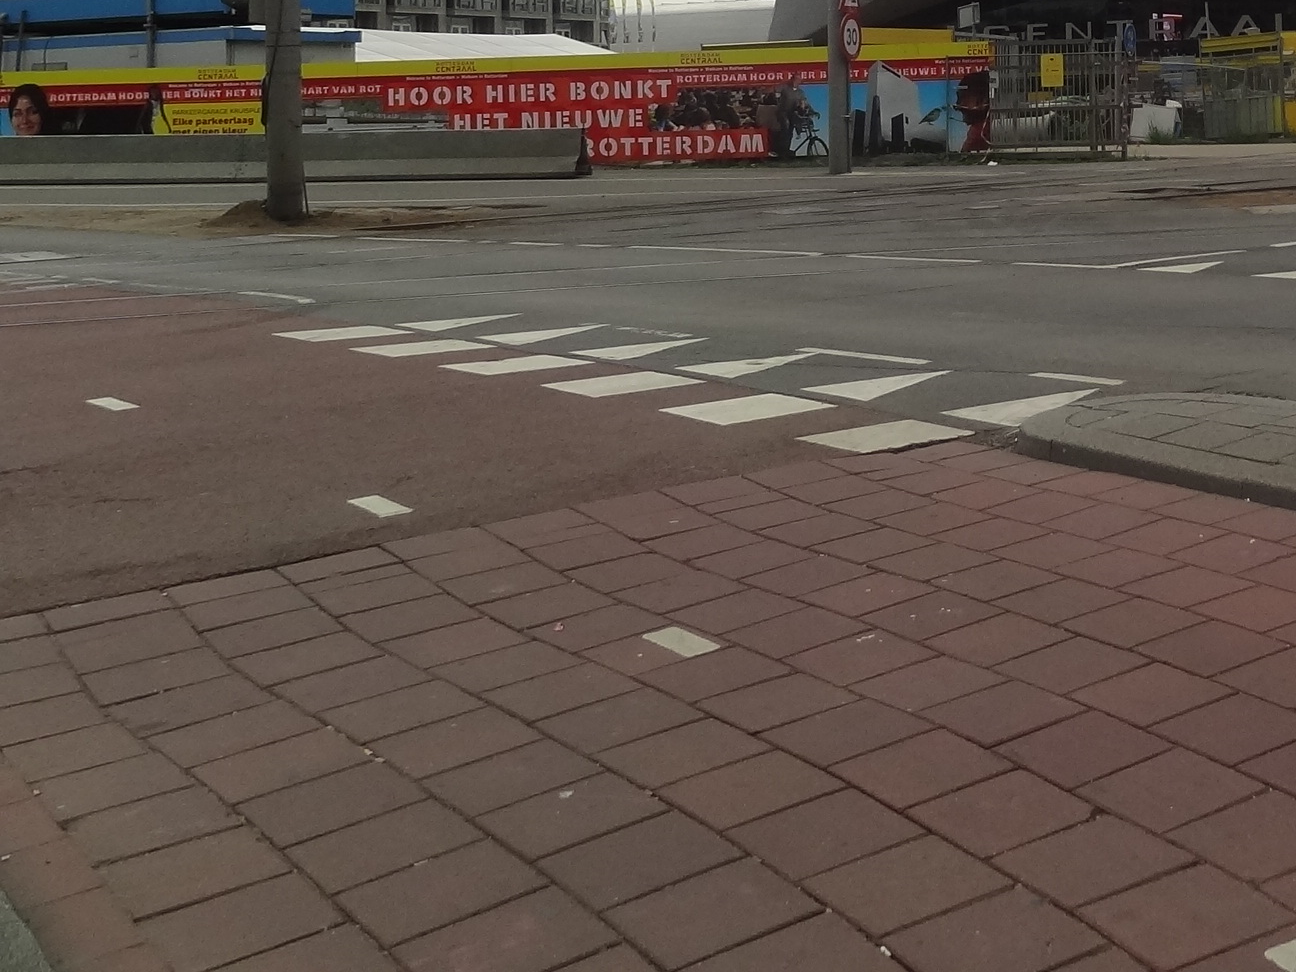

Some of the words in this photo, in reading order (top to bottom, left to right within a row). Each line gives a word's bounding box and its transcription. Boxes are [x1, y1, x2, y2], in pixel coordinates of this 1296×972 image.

[846, 28, 858, 46] 30
[676, 73, 747, 84] ROTTERDAM
[750, 72, 784, 81] HOOR
[50, 92, 116, 102] ROTTERDAM
[118, 92, 150, 100] HOOR
[184, 89, 222, 98] BONKT
[226, 88, 246, 97] HET
[301, 86, 329, 94] HART
[332, 84, 355, 94] VAN
[387, 85, 473, 107] HOOR
[486, 83, 557, 104] HIER
[569, 79, 672, 101] BONKT
[172, 118, 194, 126] Elke
[196, 116, 254, 126] parkeerlaag
[453, 113, 509, 130] HET
[521, 108, 644, 129] NIEUWE
[586, 133, 765, 158] ROTTERDAM
